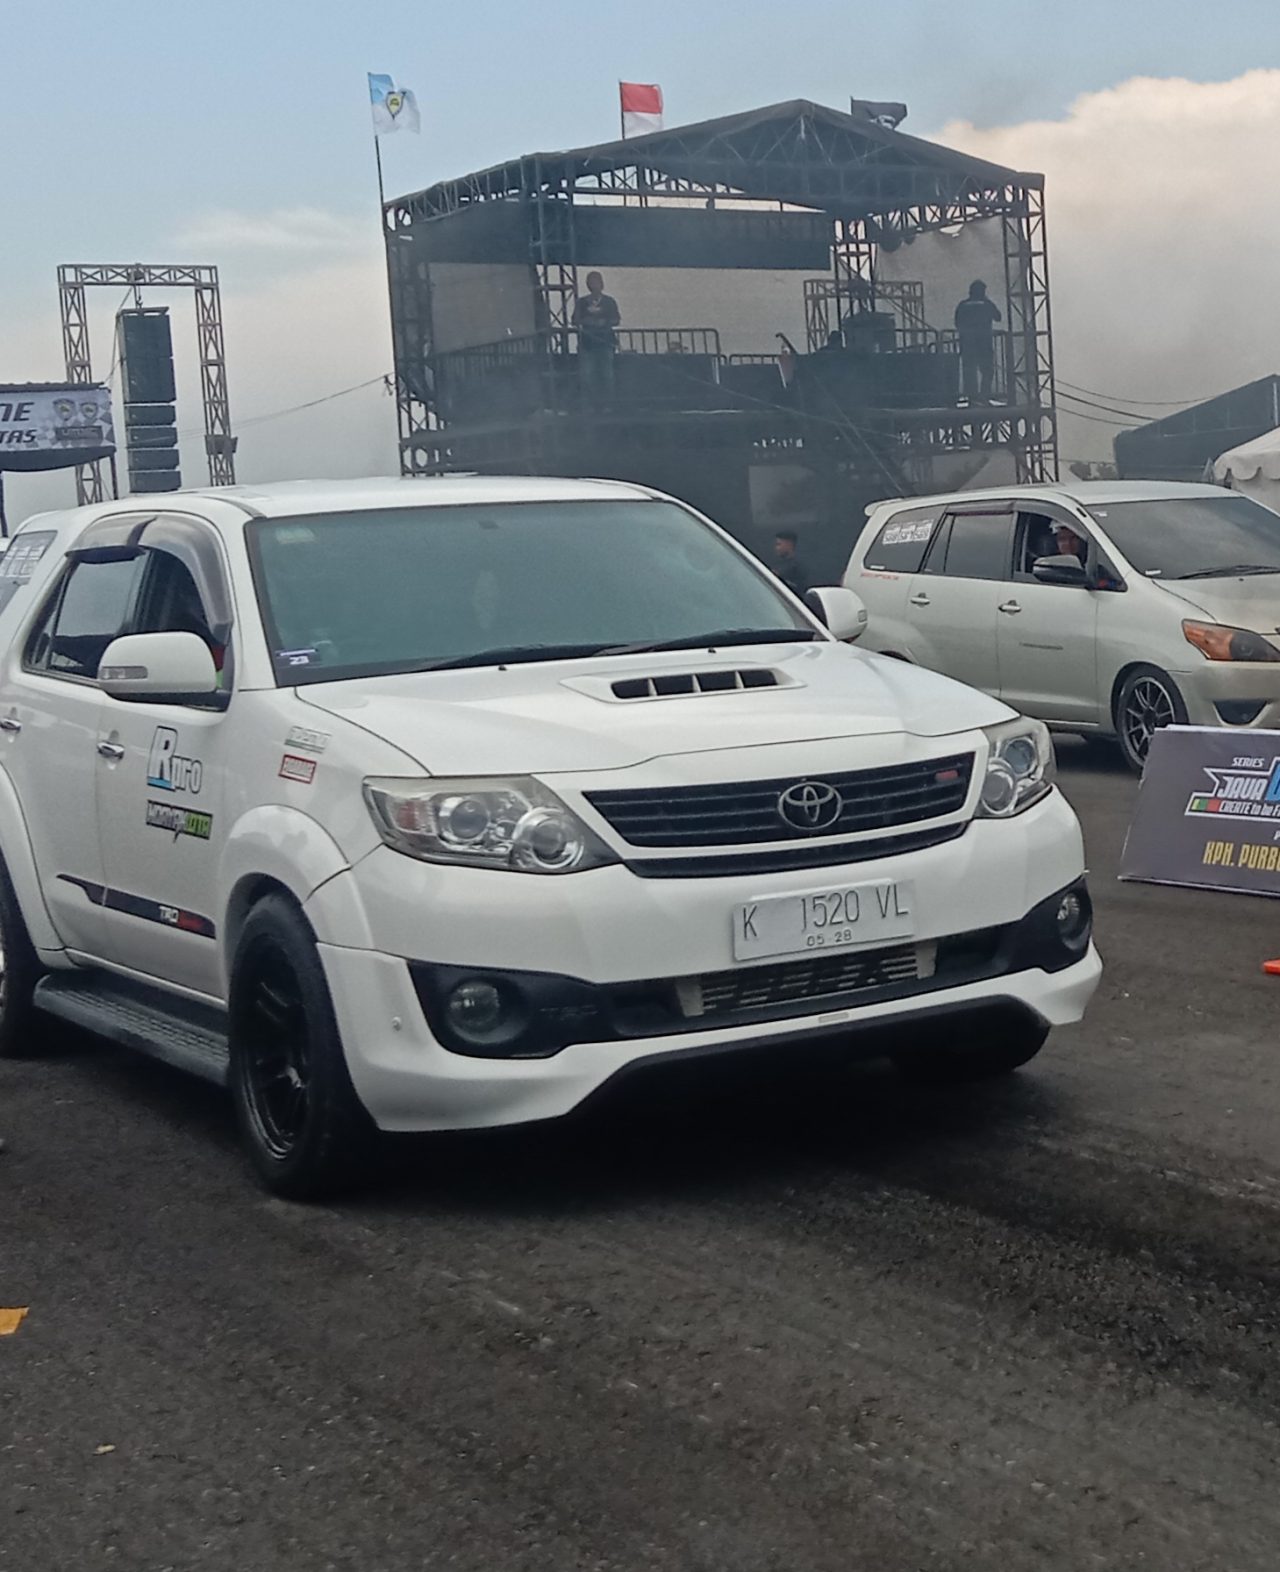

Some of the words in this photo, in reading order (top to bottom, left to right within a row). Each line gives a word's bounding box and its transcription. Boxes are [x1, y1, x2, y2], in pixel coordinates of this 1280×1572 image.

[1232, 757, 1265, 768] SERIES
[1217, 776, 1268, 800] JAVA
[743, 904, 758, 940] K
[801, 889, 860, 932] 1520
[876, 884, 909, 919] VL
[806, 933, 826, 947] 05
[834, 929, 853, 944] 28
